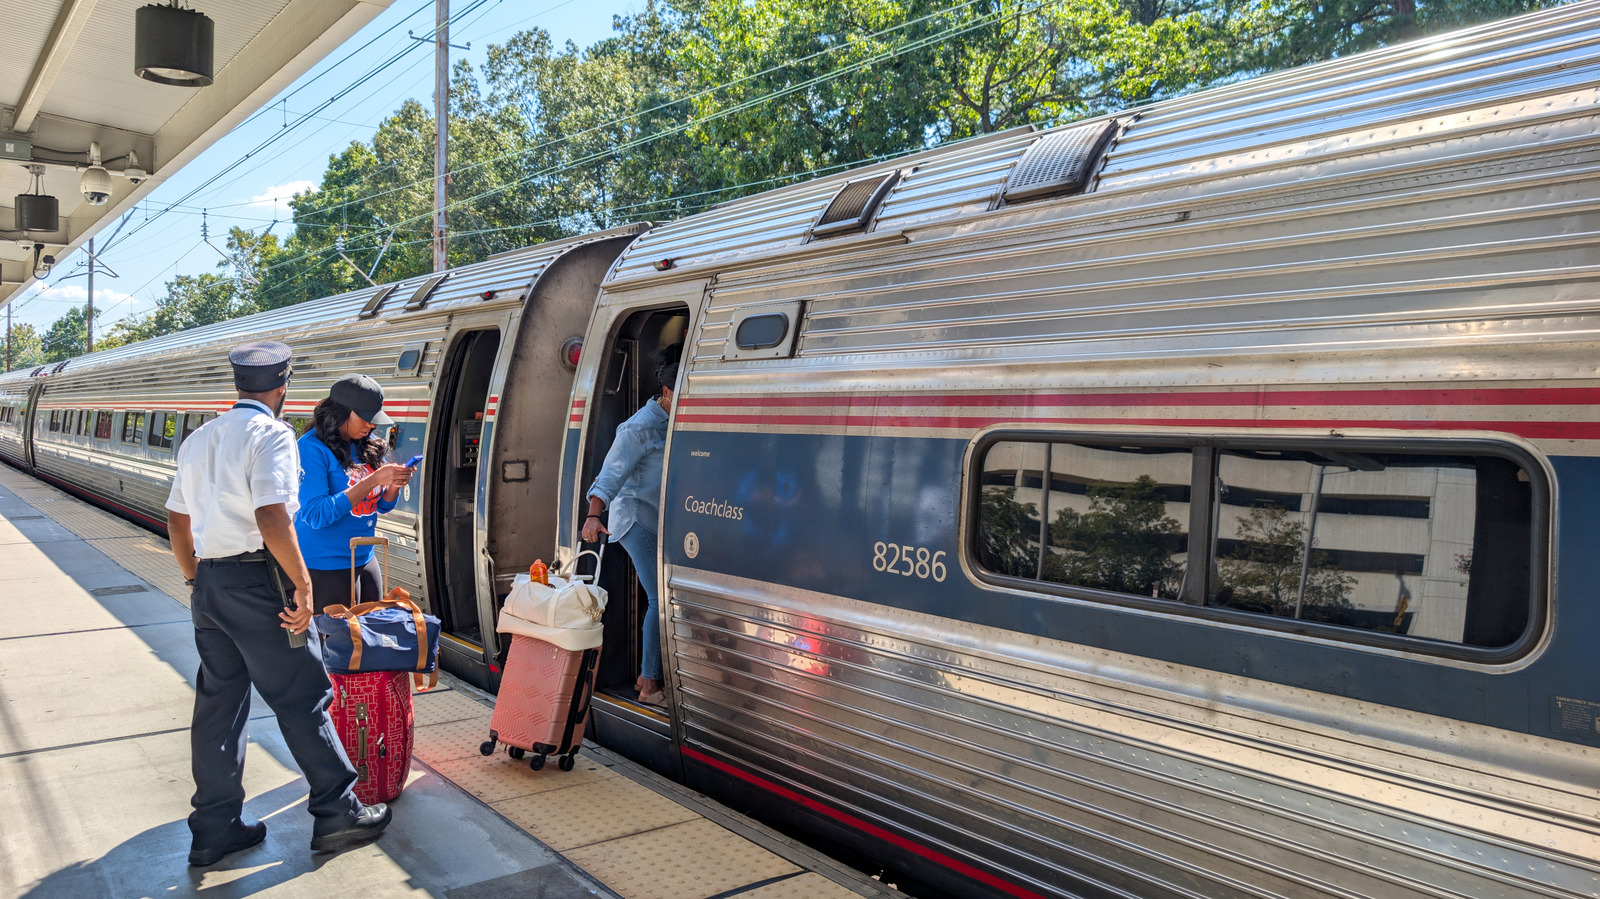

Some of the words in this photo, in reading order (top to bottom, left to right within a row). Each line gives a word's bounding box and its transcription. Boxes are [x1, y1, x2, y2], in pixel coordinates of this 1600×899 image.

[690, 449, 711, 458] welcome
[684, 495, 744, 521] Coachclass
[872, 541, 947, 583] 82586
